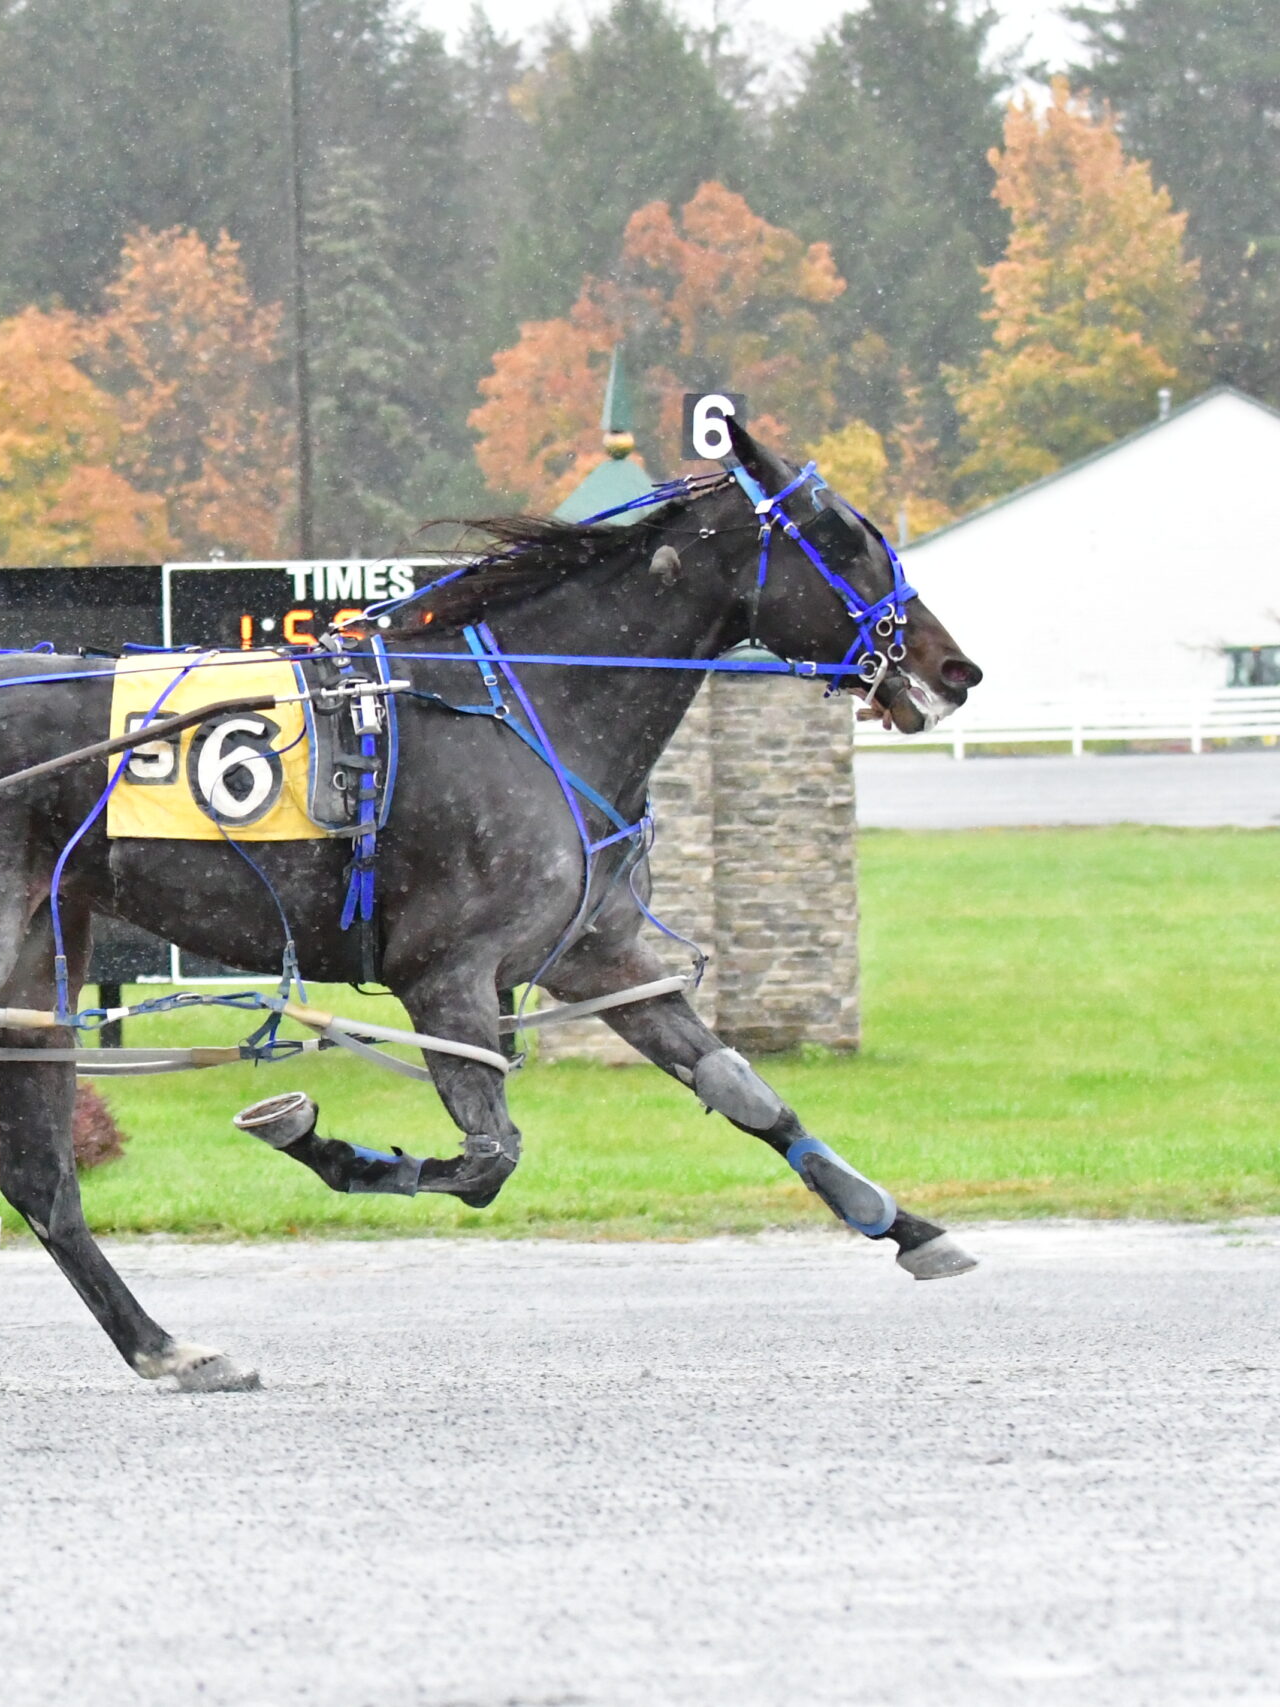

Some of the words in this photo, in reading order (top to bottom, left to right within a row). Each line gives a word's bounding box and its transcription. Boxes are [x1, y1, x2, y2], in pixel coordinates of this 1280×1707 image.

[692, 394, 735, 460] 6
[285, 565, 416, 601] TIMES
[197, 718, 273, 818] 6
